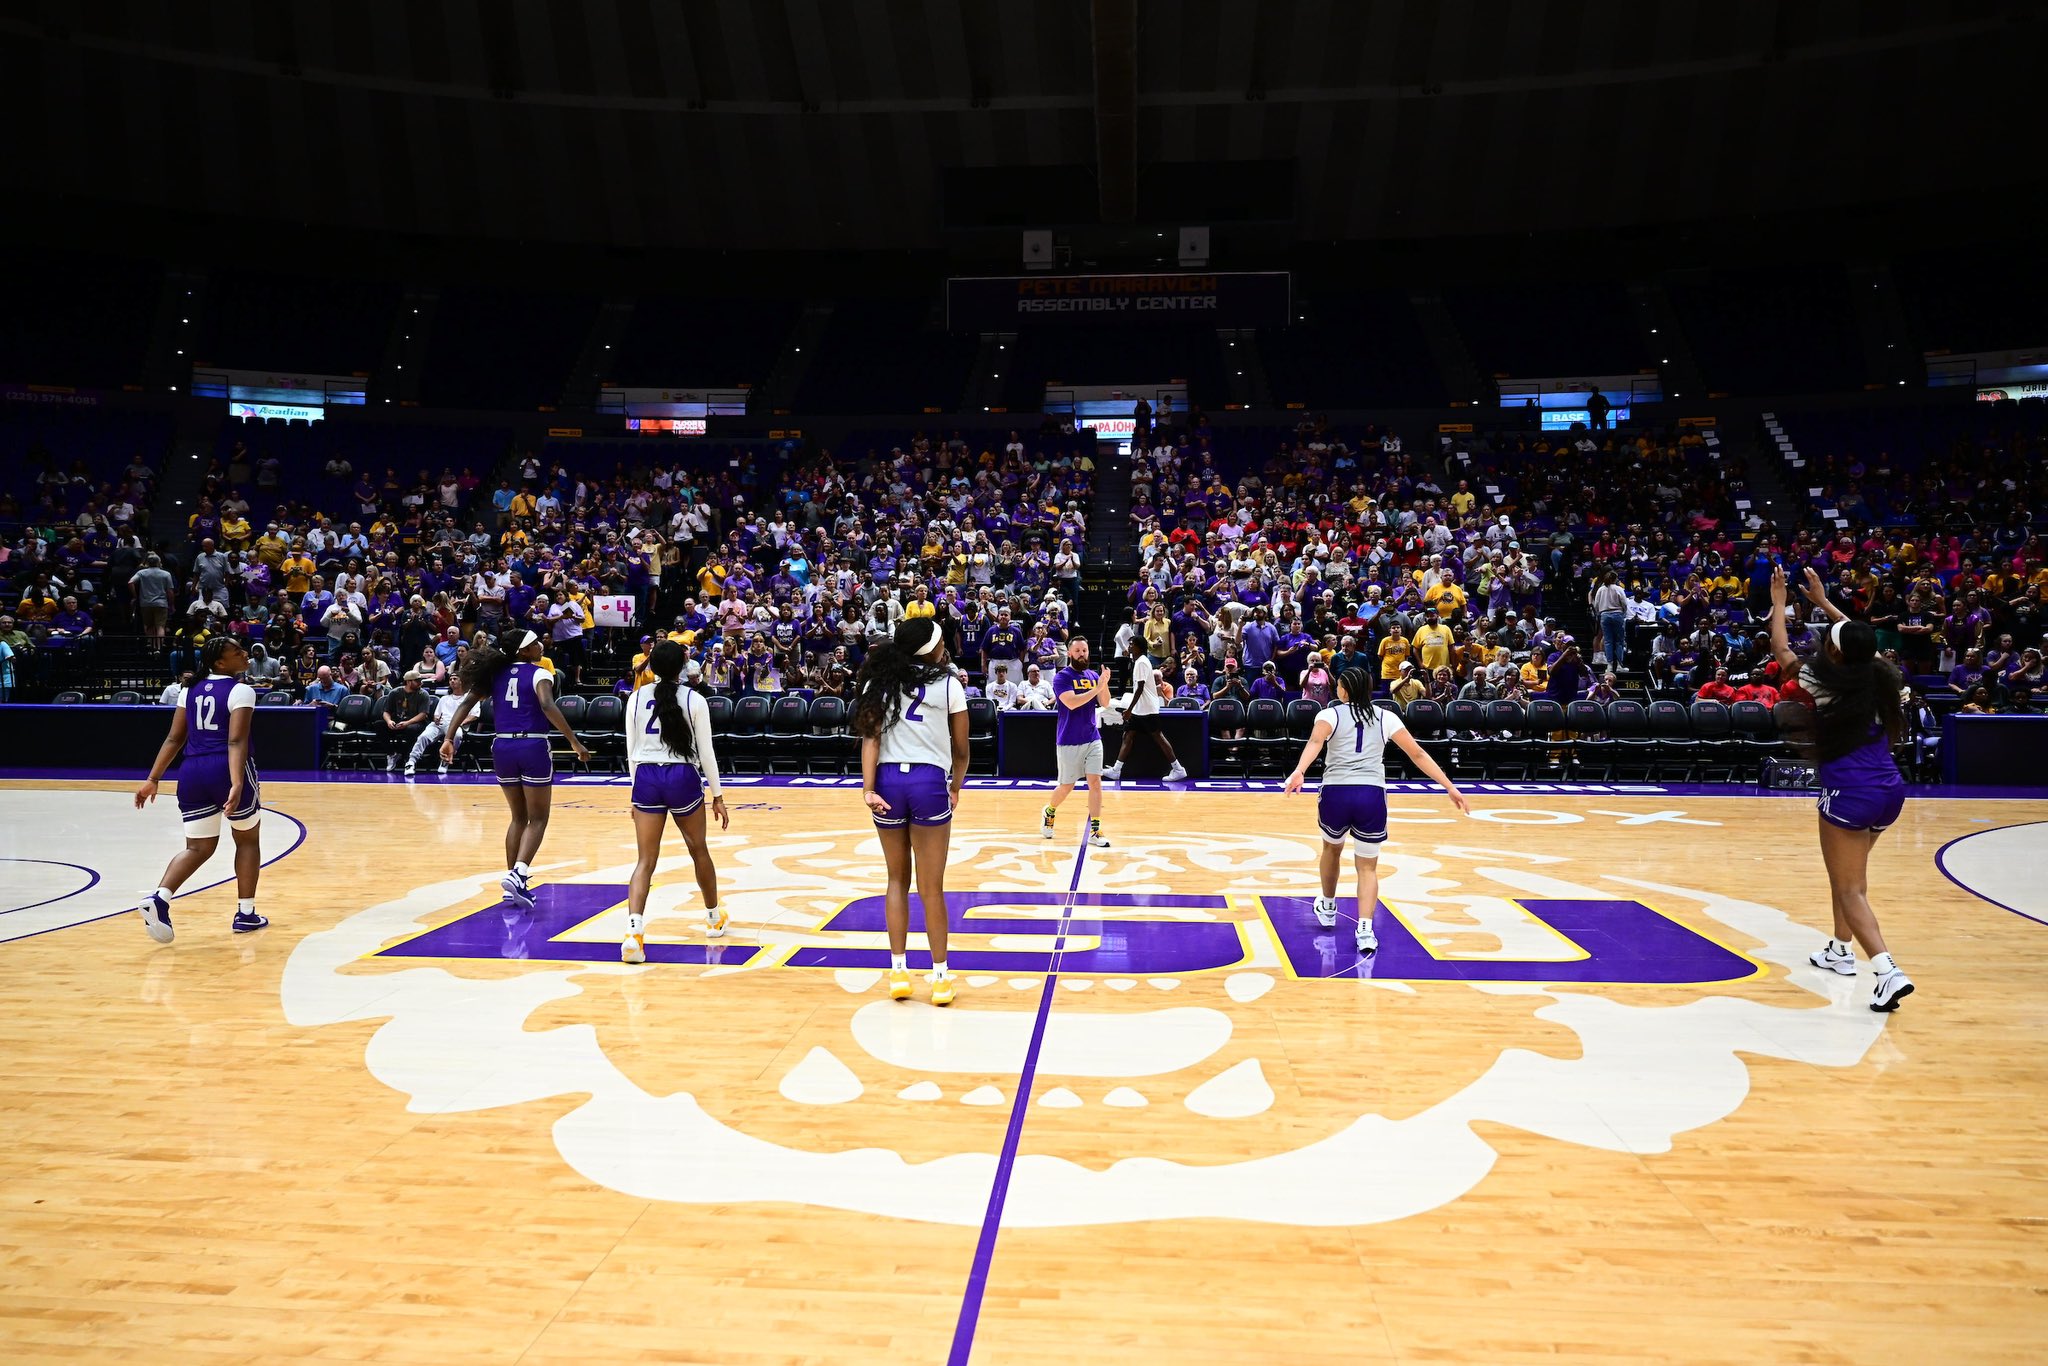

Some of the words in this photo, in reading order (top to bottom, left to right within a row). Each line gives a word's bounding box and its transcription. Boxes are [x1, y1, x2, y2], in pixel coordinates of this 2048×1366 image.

[1018, 278, 1080, 295] PETE
[1088, 276, 1217, 294] MARAVICH
[1018, 297, 1129, 312] ASSEMBLY
[1136, 295, 1217, 310] CENTER
[259, 406, 309, 417] Acadian
[616, 600, 631, 622] 4
[962, 624, 980, 632] LSU
[966, 632, 976, 641] 11
[597, 677, 610, 685] 102
[1072, 679, 1097, 690] LSU
[1624, 680, 1640, 689] 105
[505, 678, 519, 708] 4
[905, 683, 926, 722] 2
[195, 695, 218, 730] 12
[1355, 721, 1364, 753] 1
[363, 884, 1772, 984] LSU
